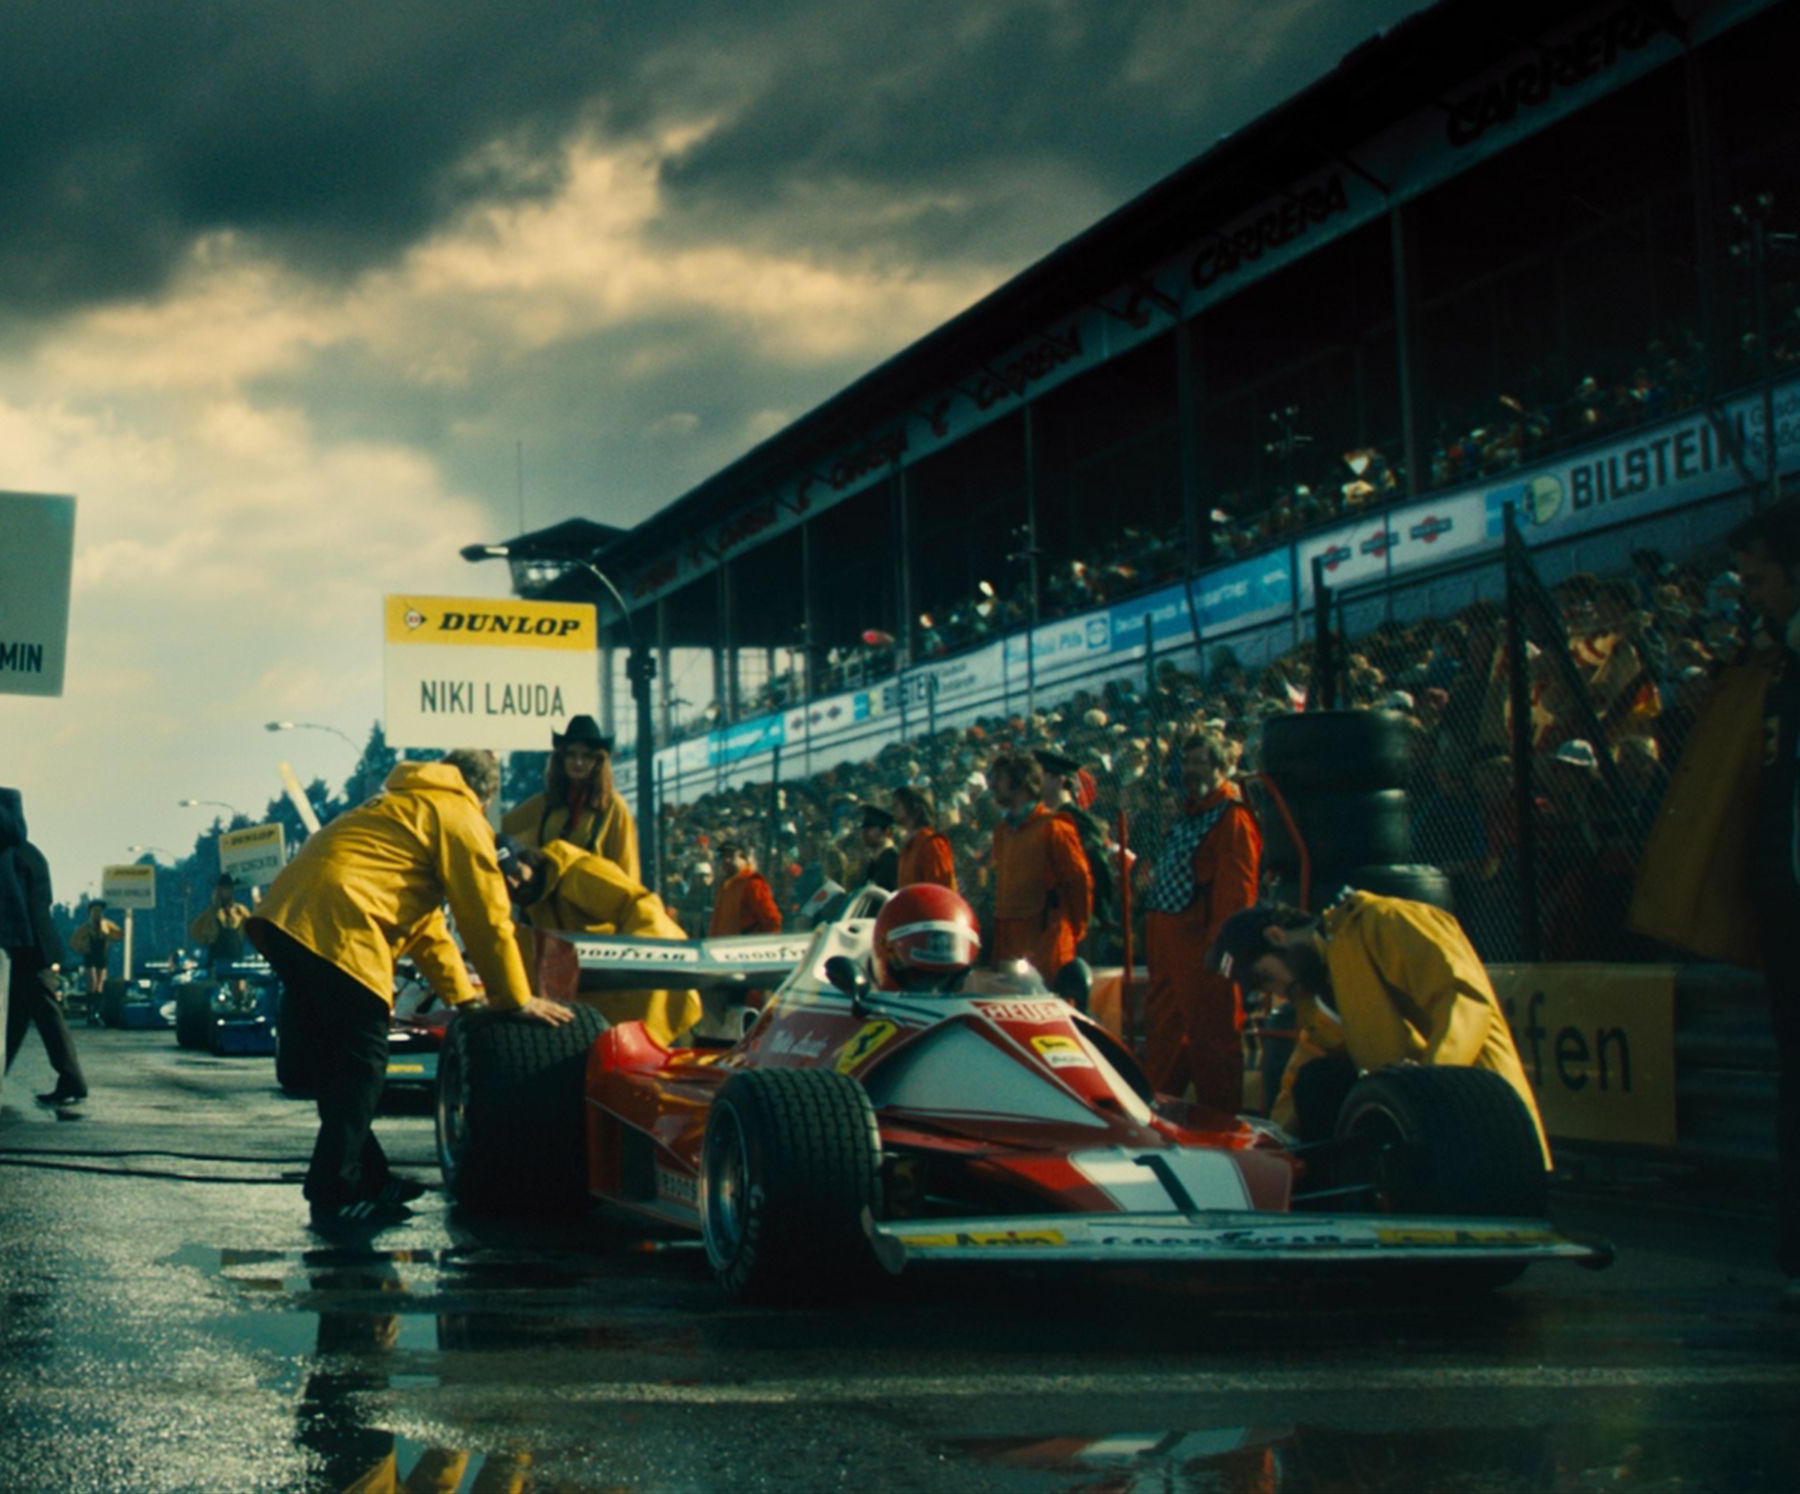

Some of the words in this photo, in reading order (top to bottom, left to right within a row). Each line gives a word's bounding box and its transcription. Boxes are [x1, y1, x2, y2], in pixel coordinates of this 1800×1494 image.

[1191, 175, 1347, 288] CARRERA
[1571, 409, 1744, 510] BILSTEIN
[439, 612, 581, 637] DUNLOP
[420, 680, 475, 714] NIKI
[484, 682, 566, 717] LAUDA
[1504, 991, 1632, 1094] fen
